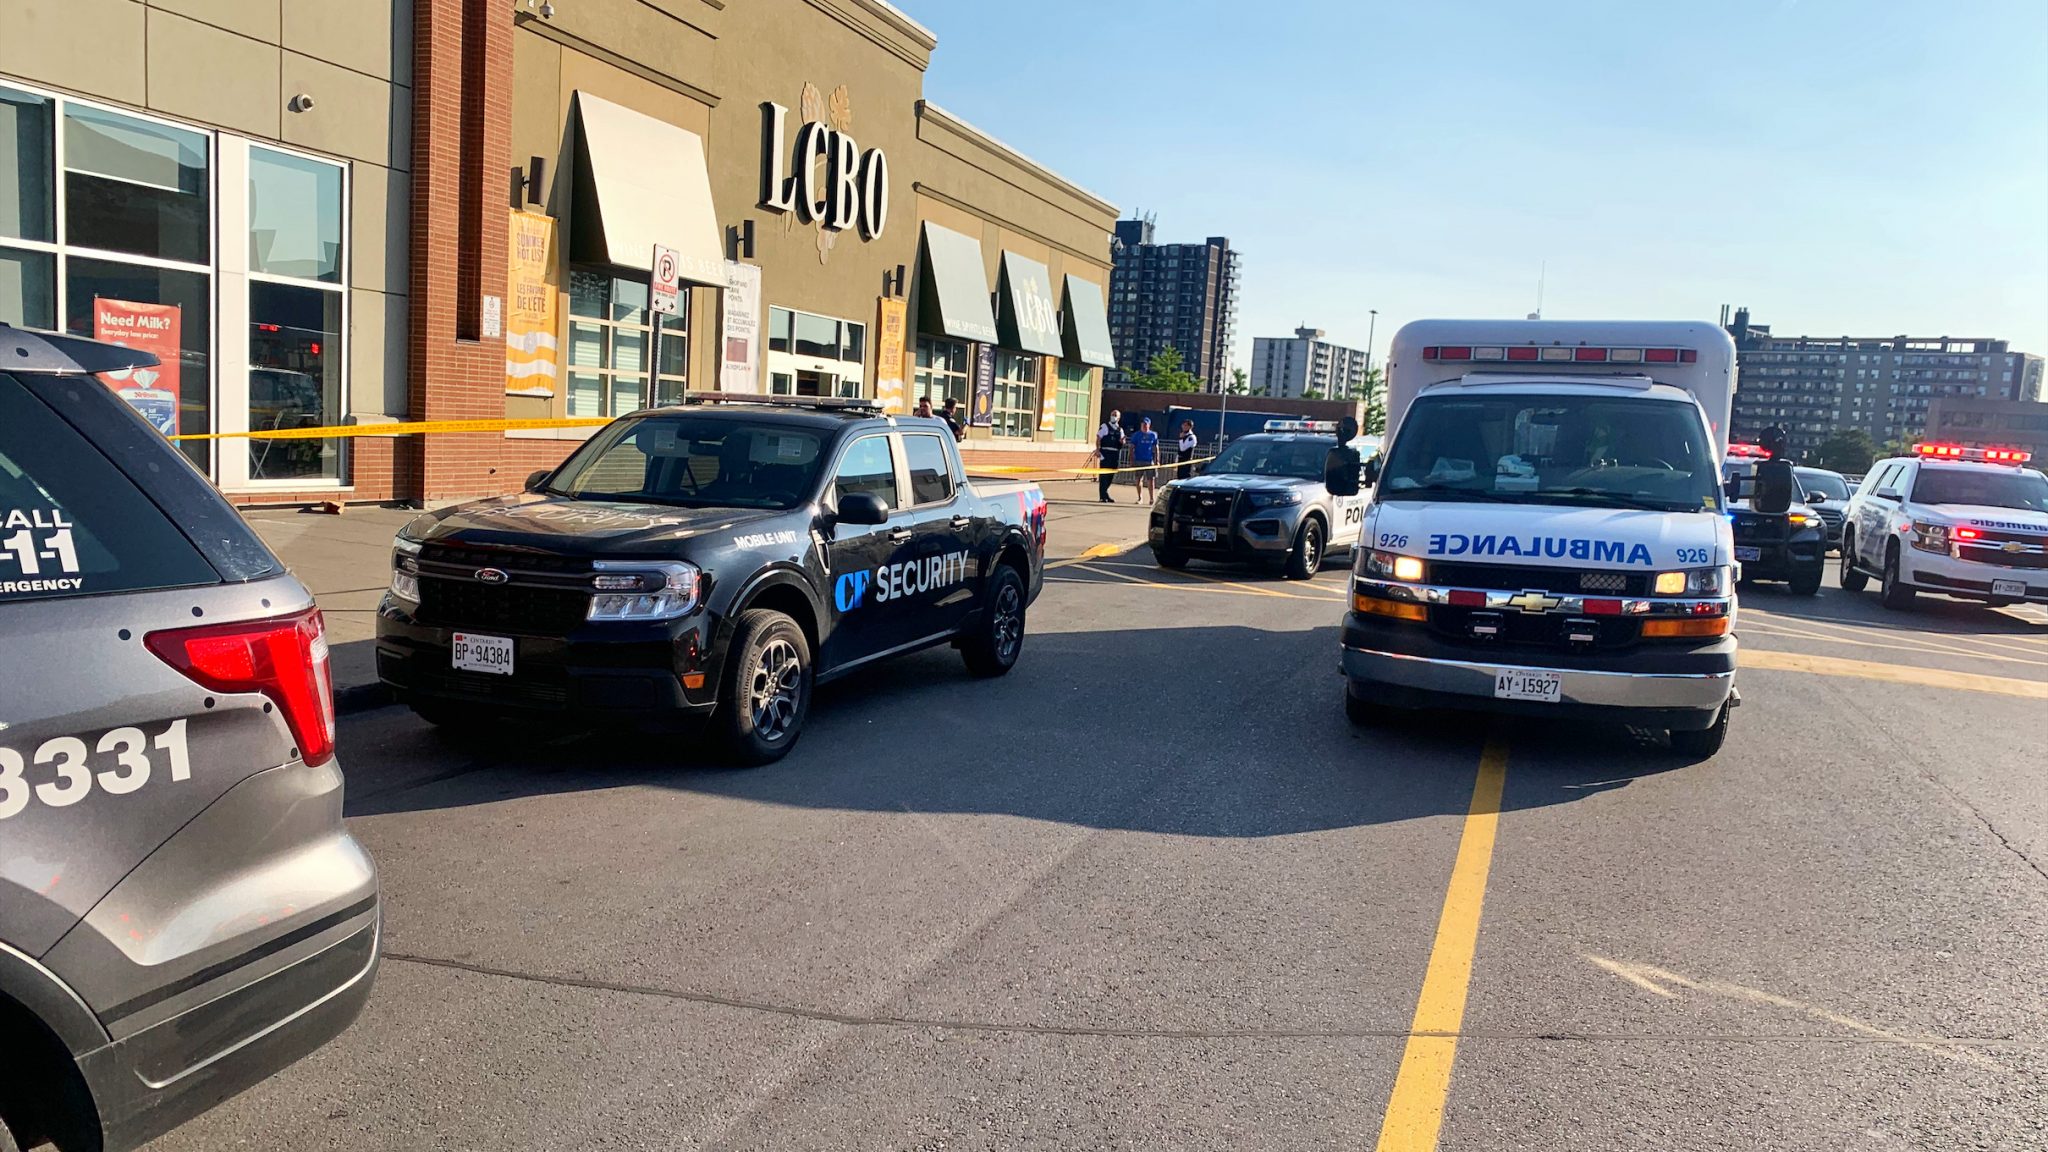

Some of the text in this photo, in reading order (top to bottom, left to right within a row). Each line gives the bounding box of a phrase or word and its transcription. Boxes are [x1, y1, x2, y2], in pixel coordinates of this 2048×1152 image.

[762, 101, 889, 241] LCBO
[531, 248, 545, 263] LIST
[1014, 288, 1055, 335] LCBO
[100, 312, 171, 330] Need Milk?
[101, 328, 129, 338] Everyday
[0, 509, 72, 528] ALL
[733, 531, 797, 549] MOBILE UNIT
[1380, 533, 1408, 548] 926
[1676, 548, 1708, 563] 926
[0, 578, 83, 593] RGENCY
[835, 550, 969, 613] CF SECURITY
[455, 643, 510, 666] BP 94384
[1498, 676, 1559, 695] AY 15927
